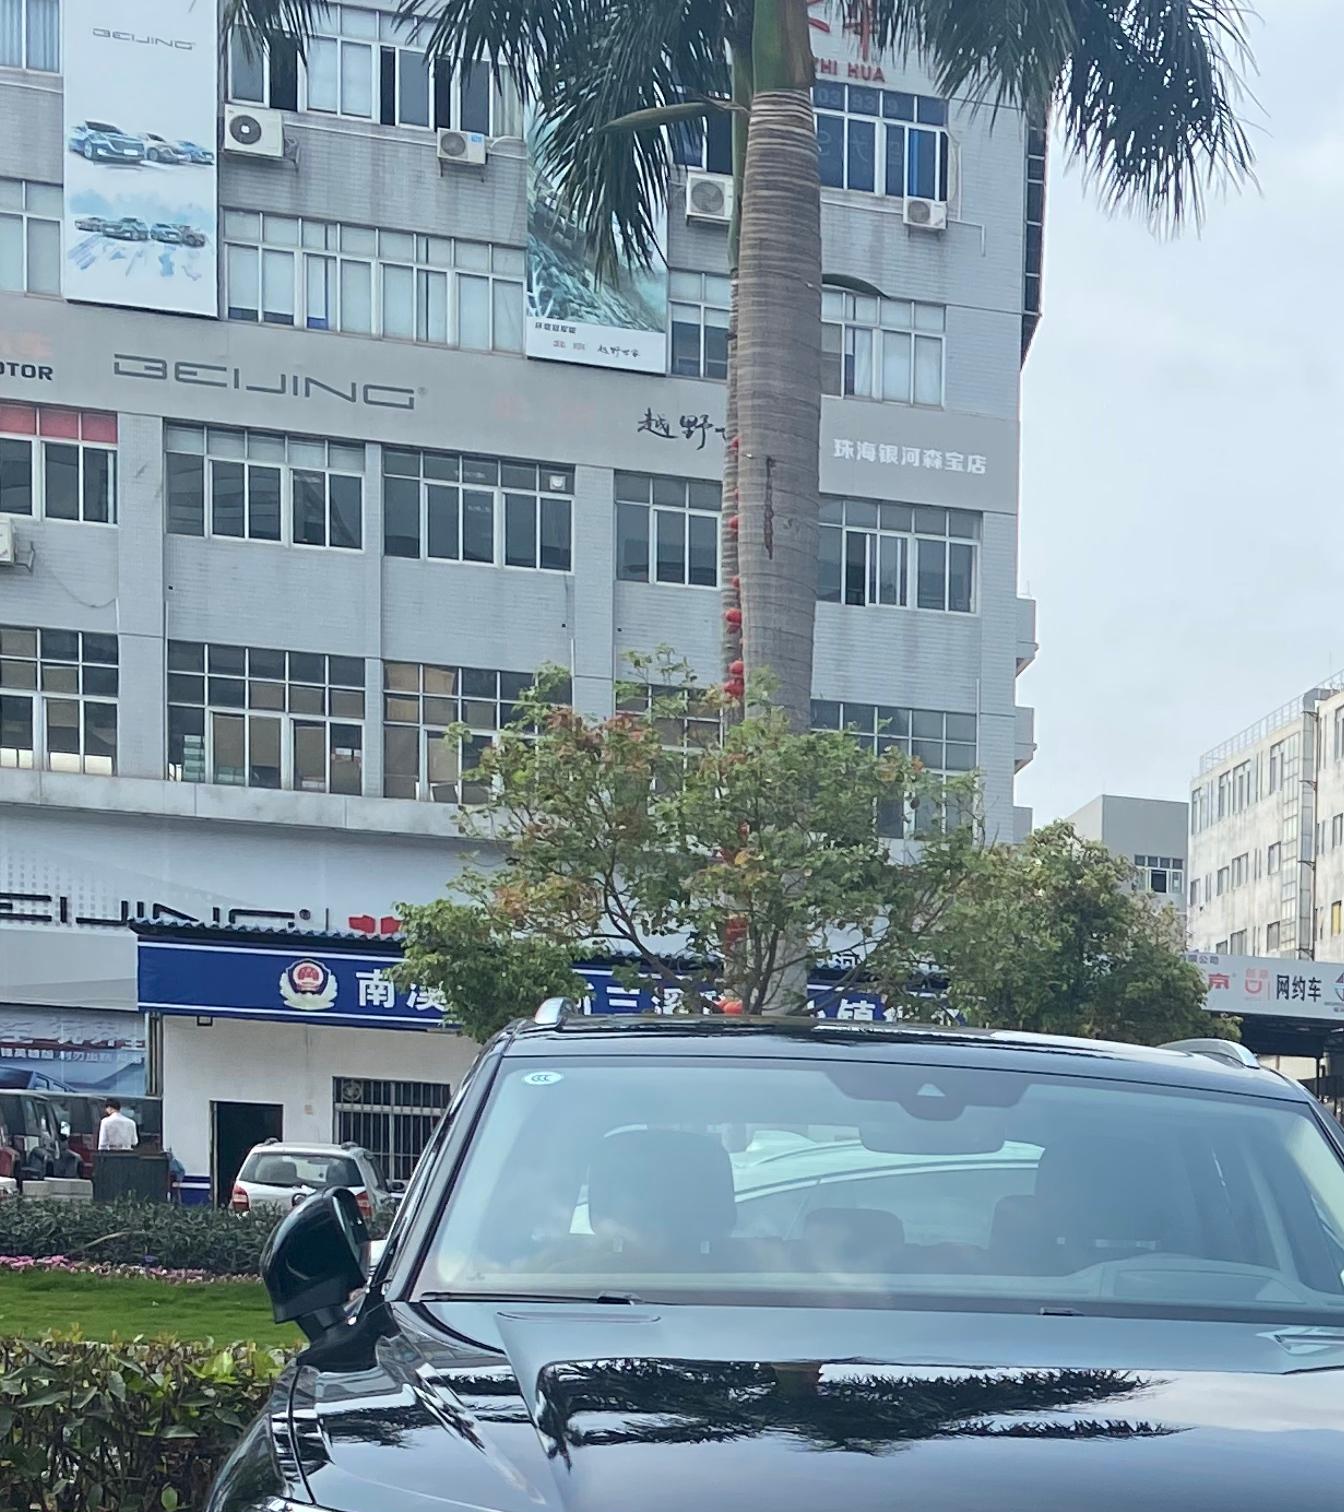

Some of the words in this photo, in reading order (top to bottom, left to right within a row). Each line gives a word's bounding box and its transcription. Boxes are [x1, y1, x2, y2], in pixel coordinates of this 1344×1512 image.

[92, 28, 193, 50] BEIJING
[848, 62, 885, 82] HUA
[113, 353, 415, 410] BEIJING
[833, 438, 987, 475] 珠海银河森宝店
[1276, 974, 1322, 1003] 网约车
